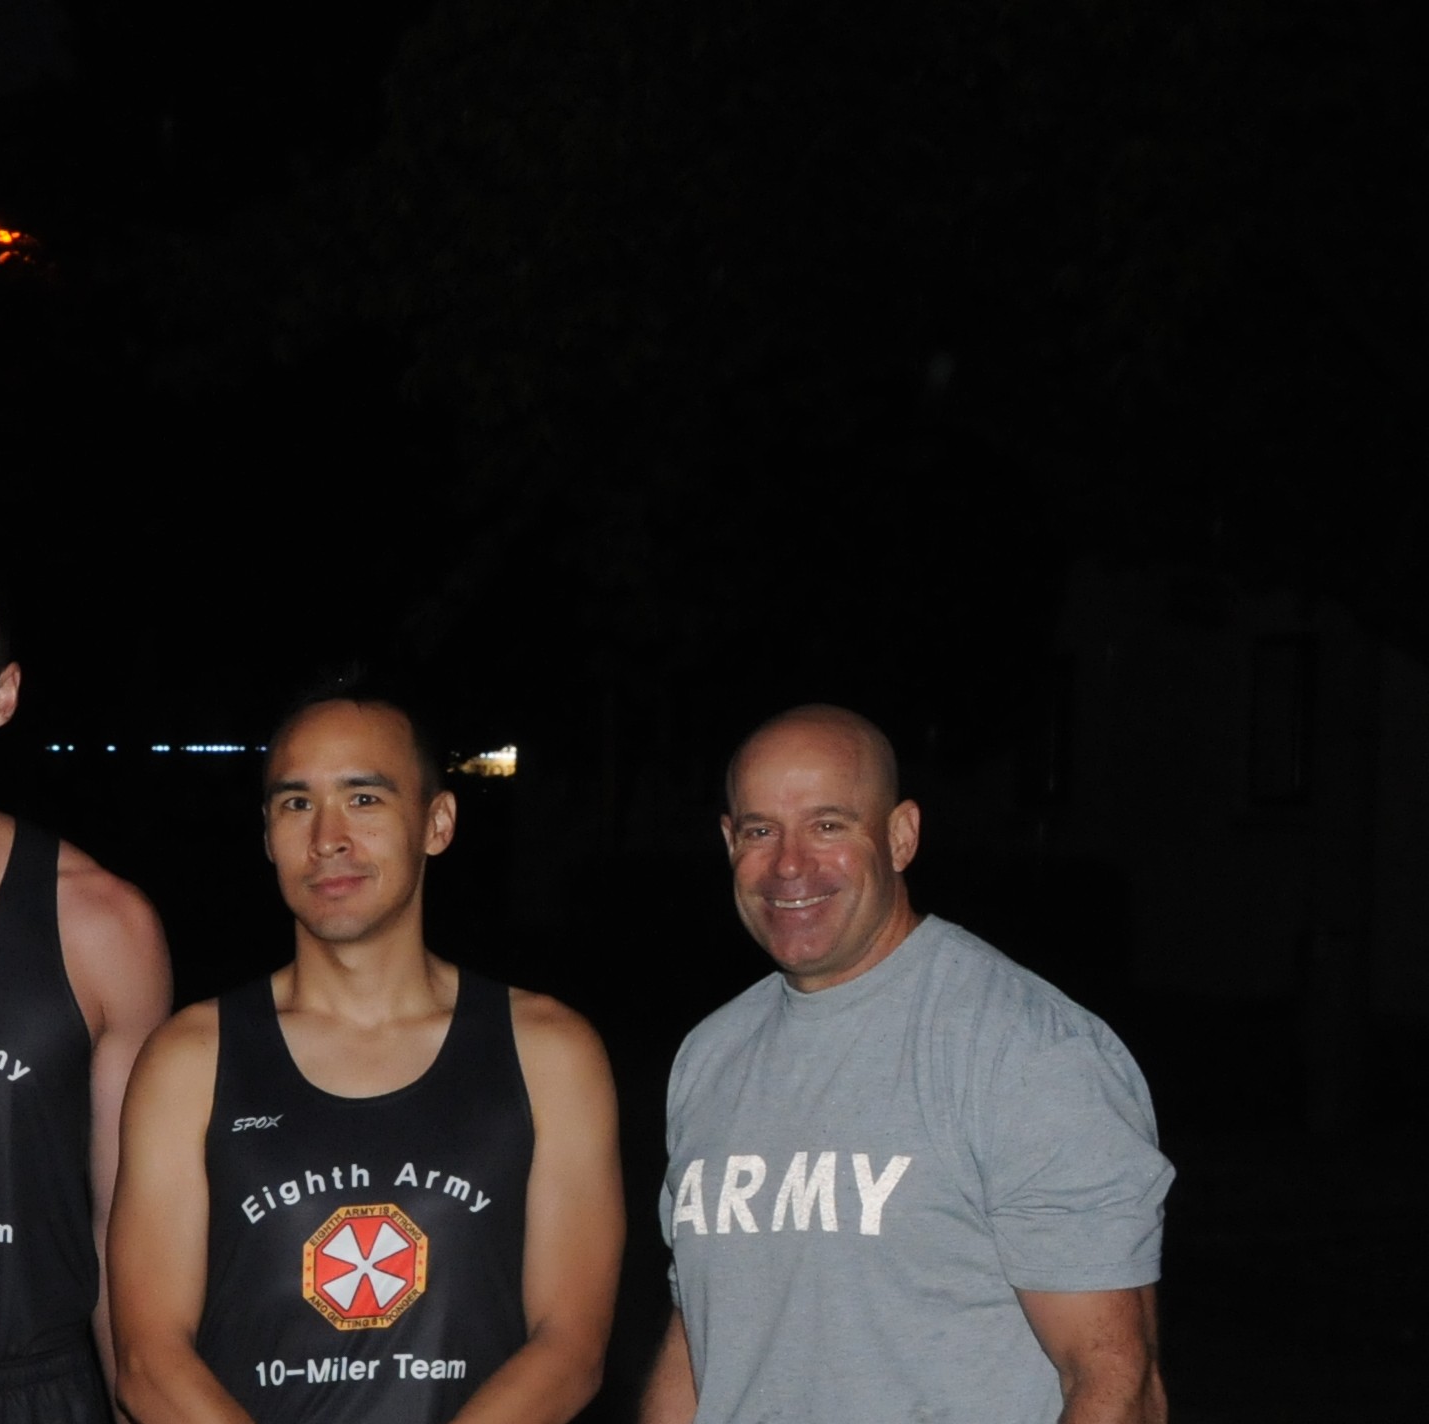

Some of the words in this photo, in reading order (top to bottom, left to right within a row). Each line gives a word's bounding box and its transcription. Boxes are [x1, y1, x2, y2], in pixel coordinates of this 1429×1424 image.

[231, 1114, 284, 1132] SPOX
[241, 1163, 370, 1225] Eighth
[394, 1162, 491, 1214] Army
[672, 1151, 912, 1238] ARMY
[309, 1214, 343, 1247] EIGHTH
[344, 1208, 377, 1217] ARMY
[379, 1206, 390, 1214] IS
[390, 1211, 423, 1241] STRONG
[255, 1356, 381, 1387] 10-Miler
[393, 1353, 466, 1380] Team
